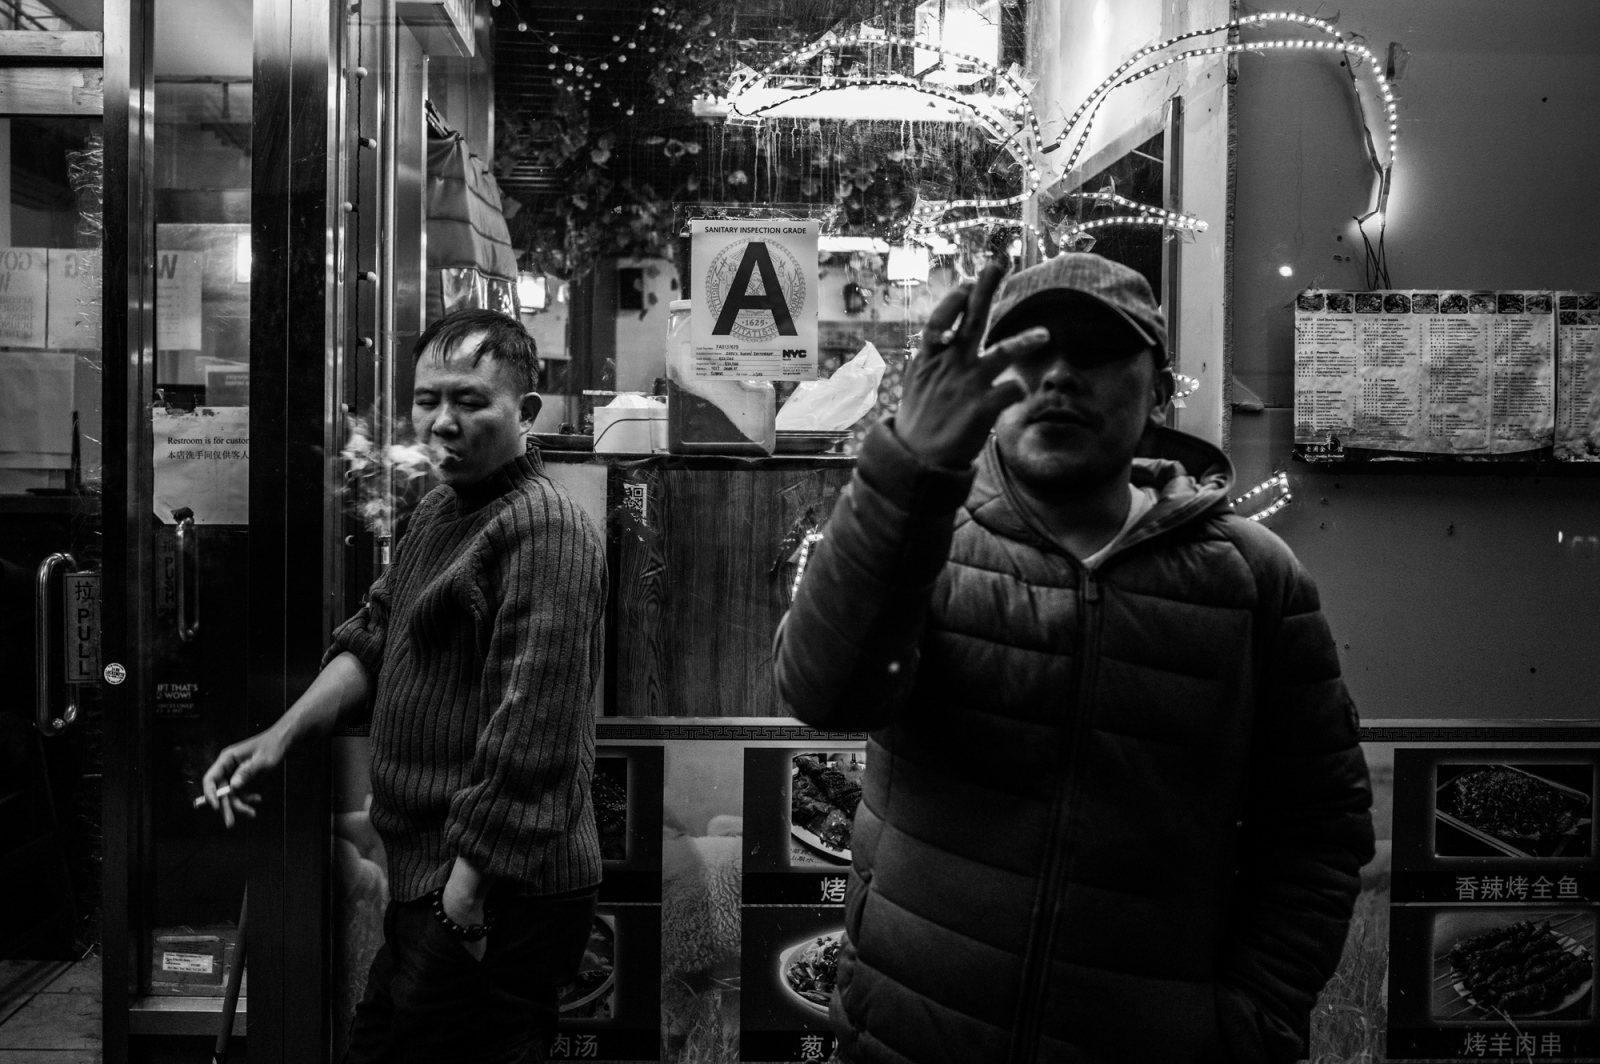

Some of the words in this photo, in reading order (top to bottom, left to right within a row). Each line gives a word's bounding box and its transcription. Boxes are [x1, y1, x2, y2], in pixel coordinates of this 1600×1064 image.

[712, 242, 798, 336] A
[782, 349, 807, 358] NYC
[167, 436, 203, 445] Restroom
[204, 436, 212, 445] is
[213, 436, 225, 445] for
[75, 581, 94, 601] 拉
[164, 557, 174, 603] PUSH
[77, 608, 91, 676] PULL
[164, 691, 191, 699] WOW!
[171, 683, 199, 691] THAT'S
[820, 877, 846, 902] 烤
[1455, 875, 1580, 901] 香辣烤全鱼
[550, 1033, 599, 1058] 肉汤
[800, 1034, 838, 1060] 葱
[1463, 1032, 1562, 1058] 烤羊肉串
